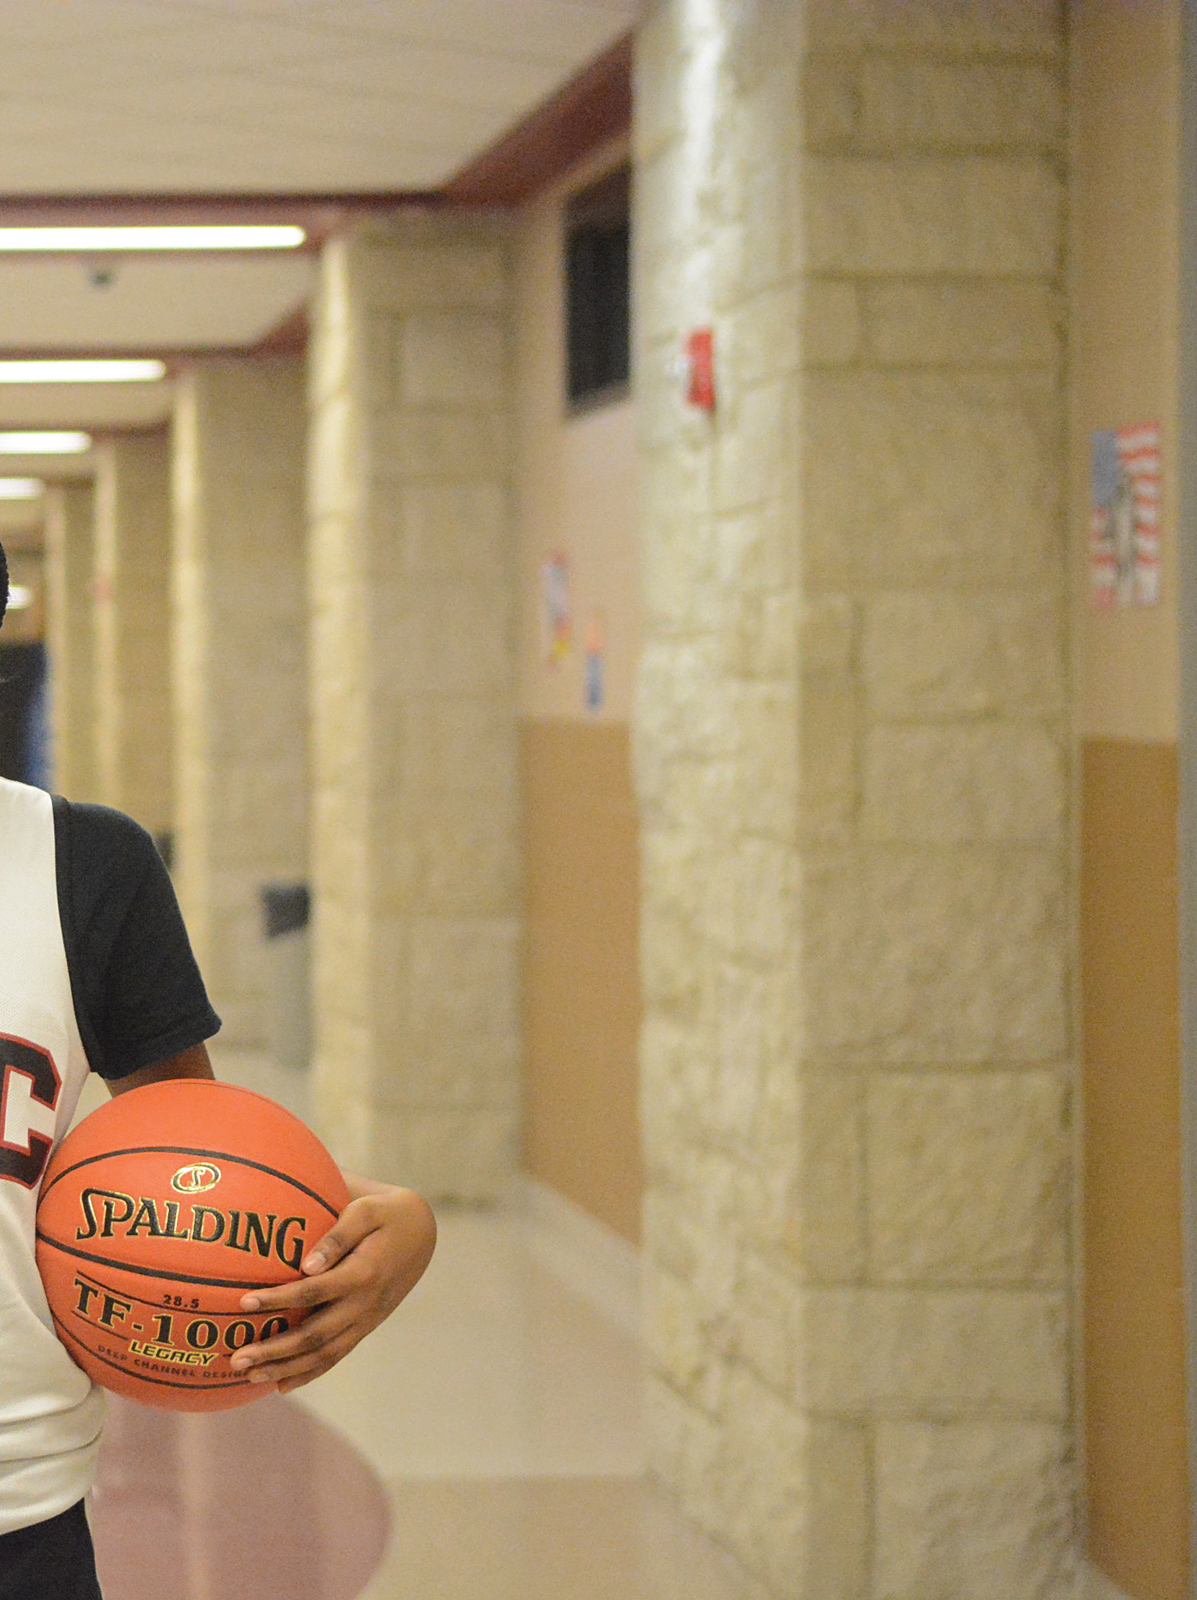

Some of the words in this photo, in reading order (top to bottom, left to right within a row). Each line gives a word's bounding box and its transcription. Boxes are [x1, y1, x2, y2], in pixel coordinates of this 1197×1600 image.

[76, 1187, 307, 1271] SPALDING
[163, 1294, 200, 1309] 28.5
[97, 1344, 128, 1361] DEEP
[134, 1358, 196, 1377] CHANNEL
[128, 1339, 219, 1367] LEGACY
